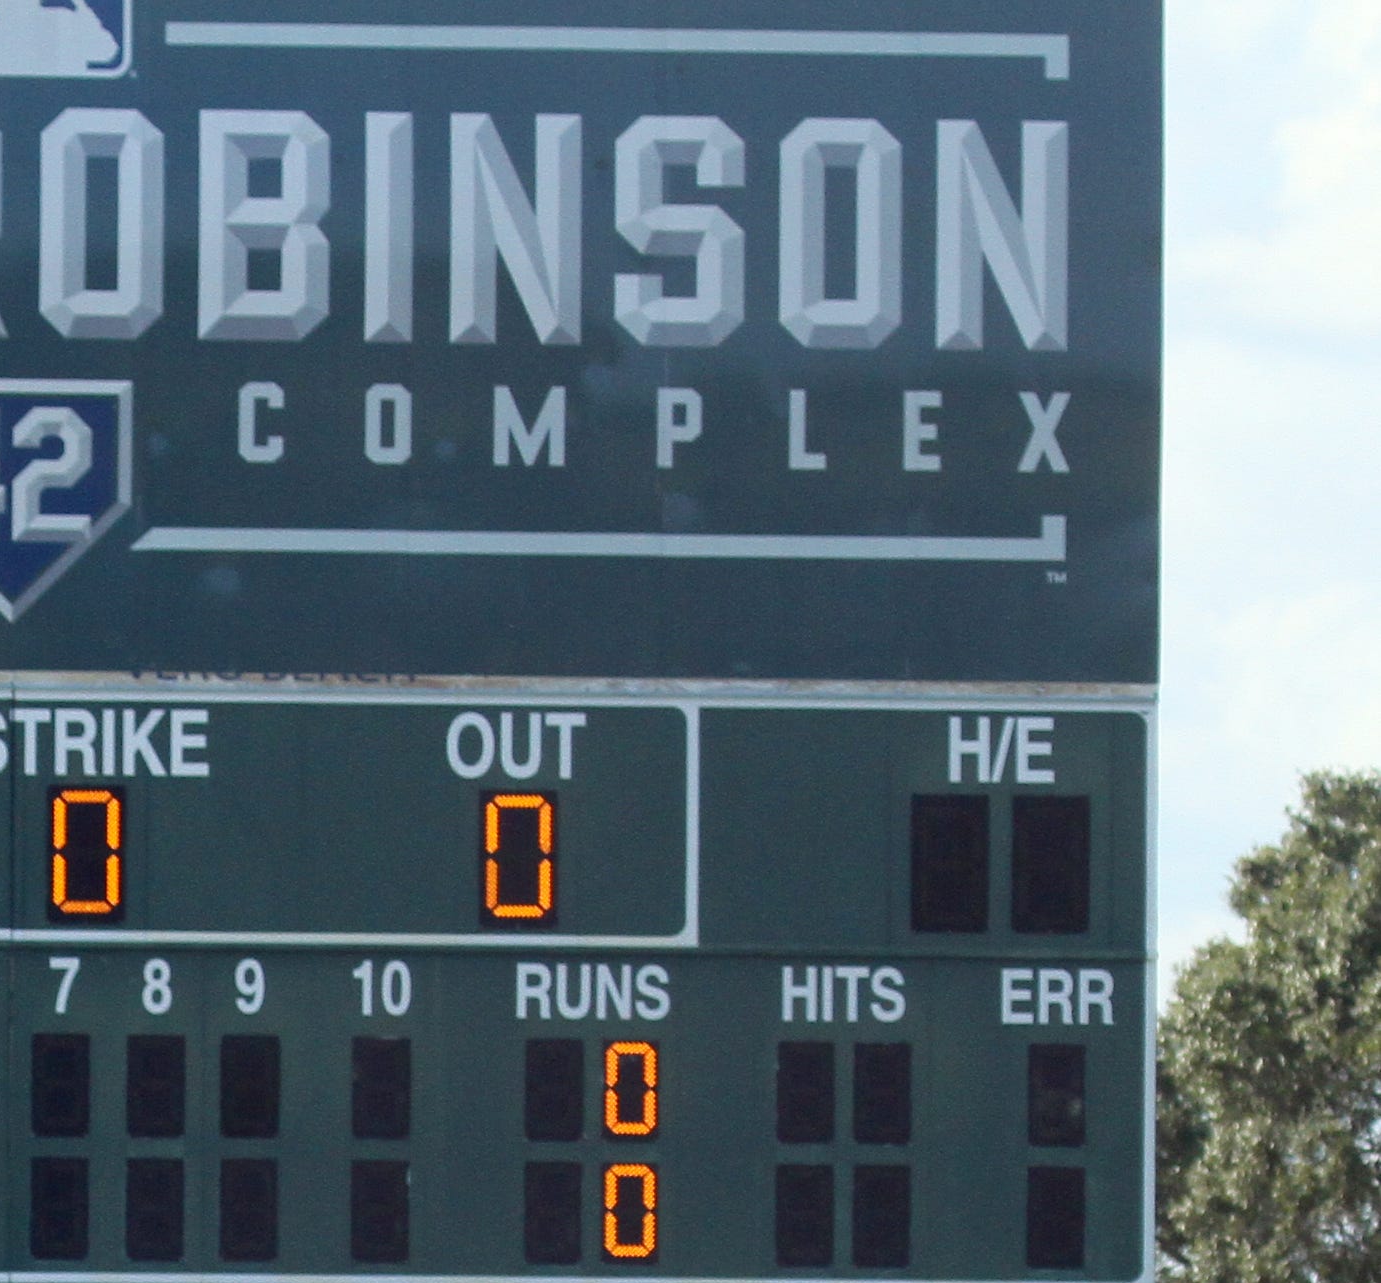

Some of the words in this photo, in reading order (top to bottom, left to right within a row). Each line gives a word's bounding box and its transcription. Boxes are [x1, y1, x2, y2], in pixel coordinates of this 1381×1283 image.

[236, 380, 1072, 474] COMPLEX
[445, 711, 588, 780] OUT
[947, 717, 1056, 784] H/E
[52, 790, 121, 914] 0
[484, 794, 552, 919] 0
[49, 957, 79, 1014] 7
[141, 958, 173, 1015] 8
[234, 958, 265, 1015] 9
[352, 959, 411, 1016] 10
[515, 963, 671, 1021] RUNS
[781, 967, 906, 1023] HITS
[1000, 969, 1115, 1026] ERR
[604, 1041, 657, 1135] 0
[604, 1164, 657, 1259] 0
